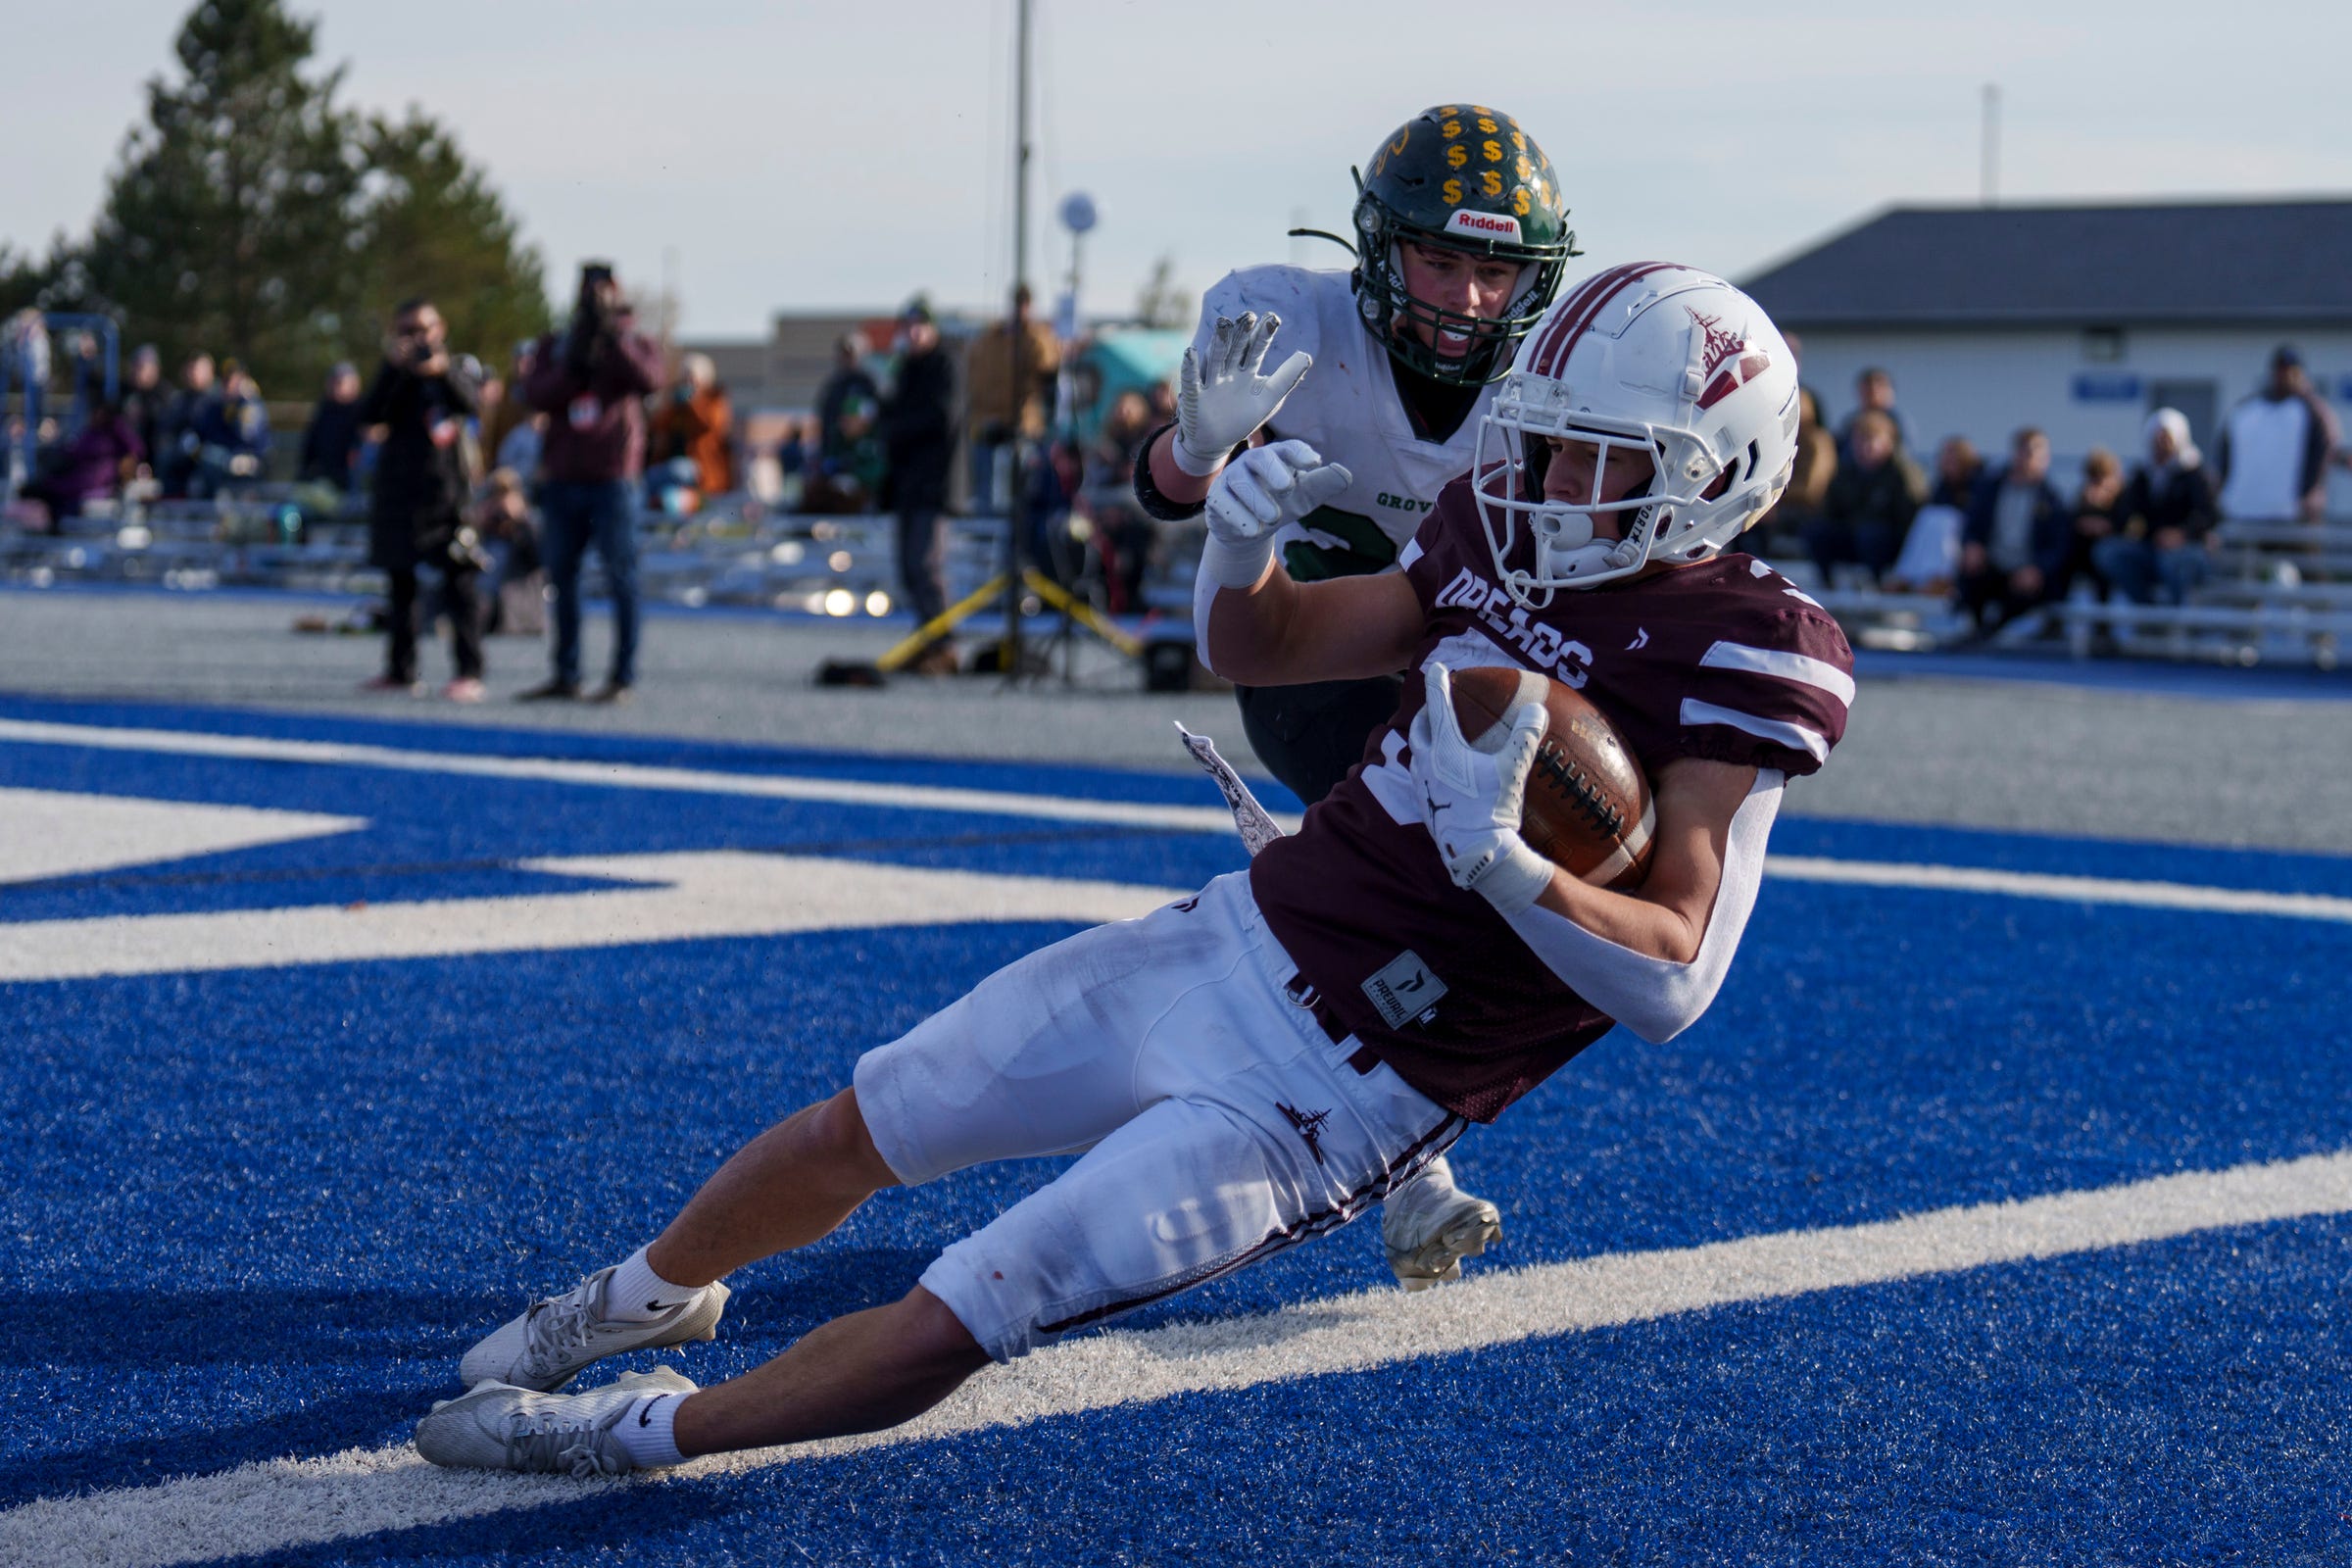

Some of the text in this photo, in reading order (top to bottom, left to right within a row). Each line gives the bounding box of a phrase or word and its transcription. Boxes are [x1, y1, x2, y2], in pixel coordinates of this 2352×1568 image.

[1458, 213, 1514, 233] Riddell
[1377, 492, 1436, 513] GROV
[1373, 978, 1408, 1020] PREVAIL
